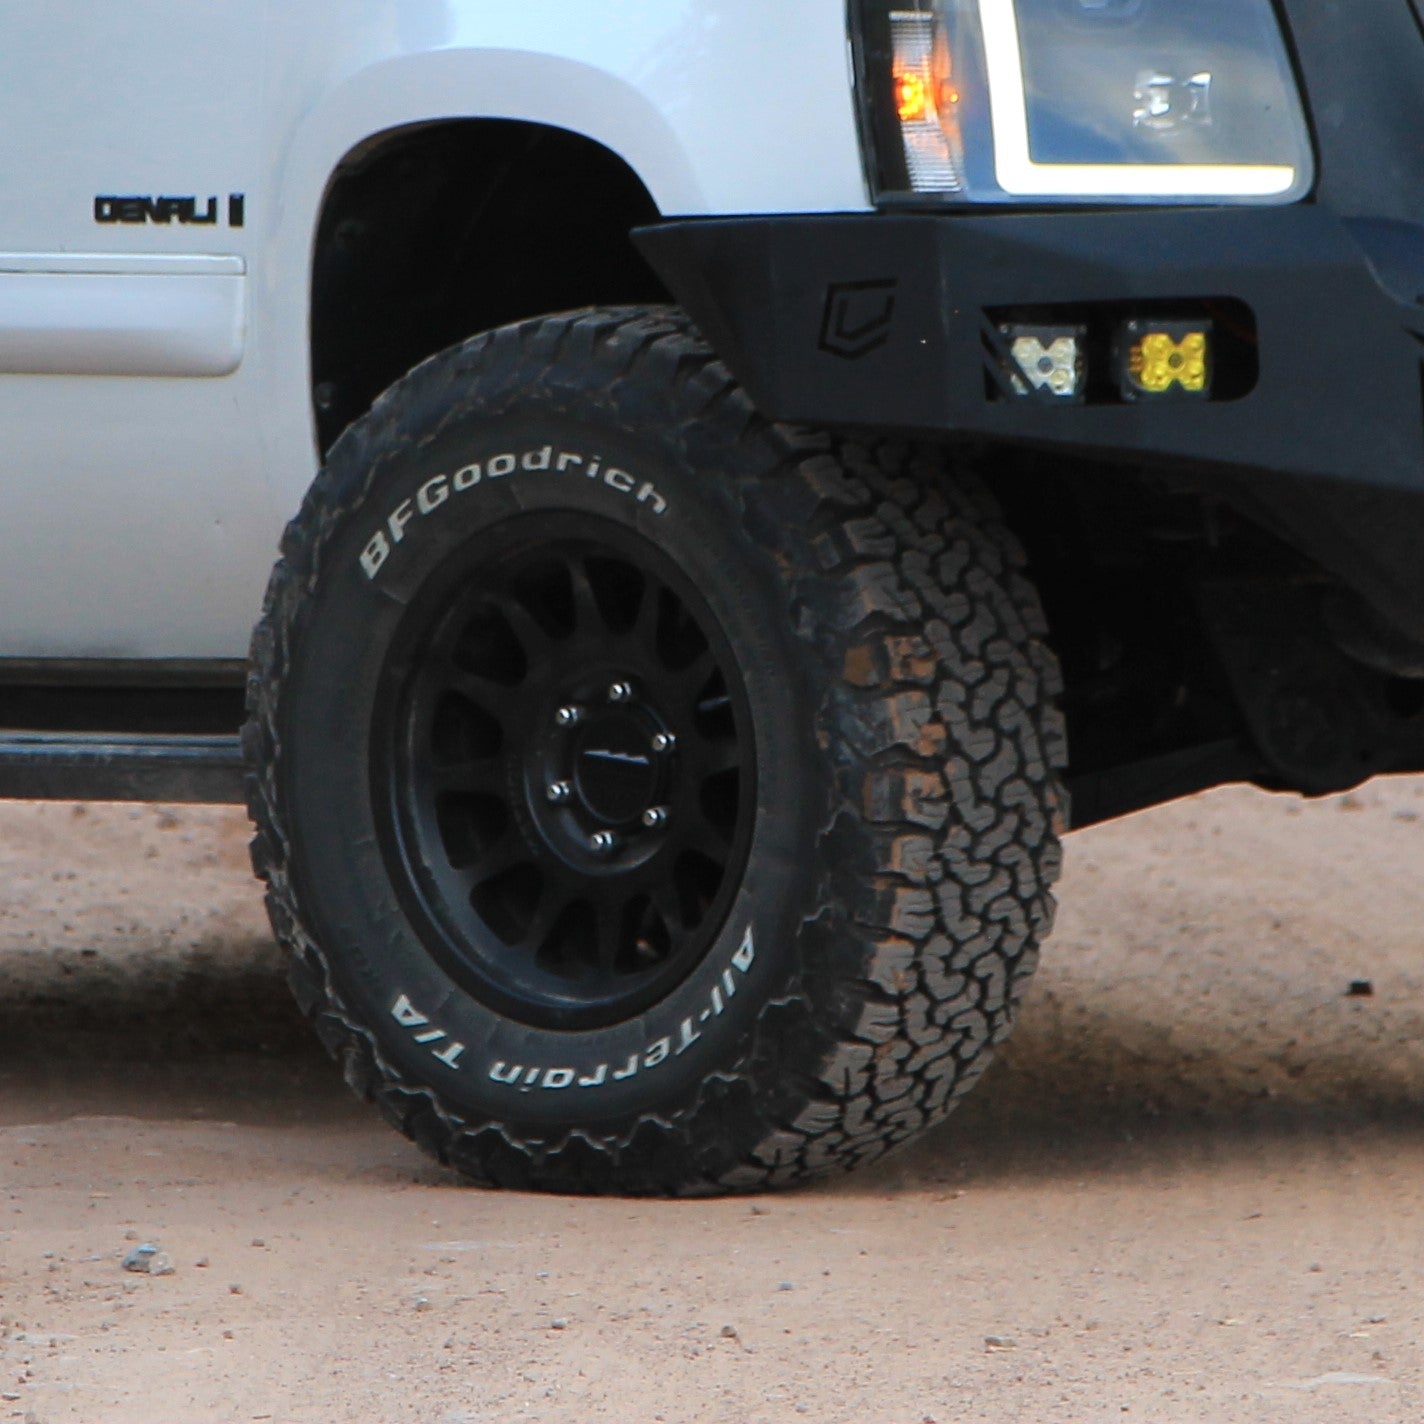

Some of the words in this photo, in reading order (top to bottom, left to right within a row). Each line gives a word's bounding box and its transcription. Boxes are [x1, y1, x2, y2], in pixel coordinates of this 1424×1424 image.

[94, 194, 218, 224] DENALI
[359, 445, 668, 580] BFGoodrich
[390, 993, 465, 1070] T/A
[488, 922, 755, 1092] All-Terrain
